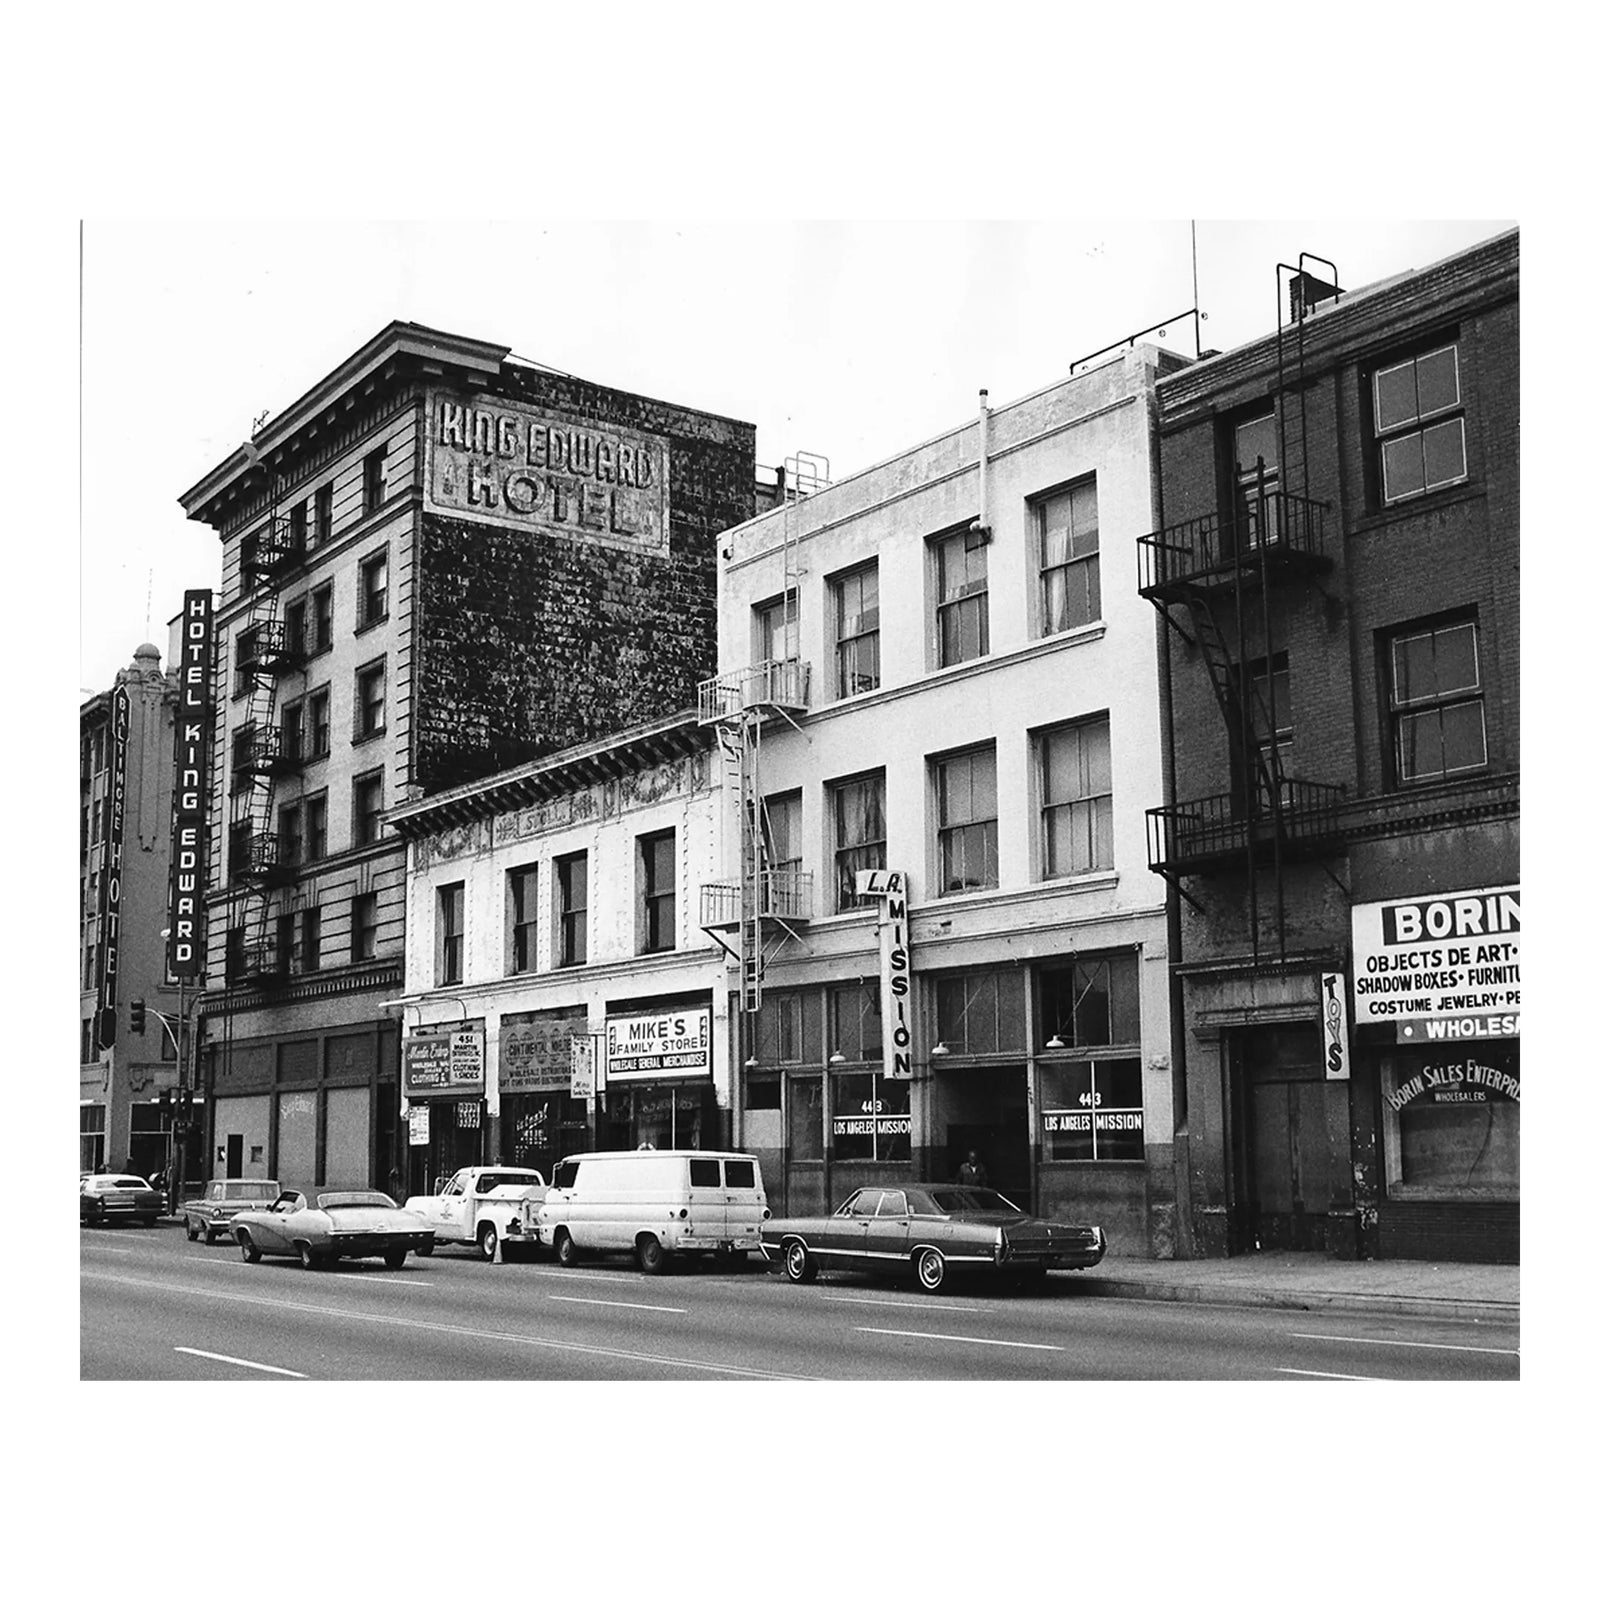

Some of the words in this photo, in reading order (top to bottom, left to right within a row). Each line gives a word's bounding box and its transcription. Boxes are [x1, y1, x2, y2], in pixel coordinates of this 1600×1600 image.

[440, 403, 518, 459] KING
[526, 424, 653, 489] EDWARD
[467, 458, 639, 536] HOTEL
[186, 601, 206, 706] HOTEL
[114, 696, 127, 830] BALTIMORE
[183, 724, 201, 809] KING
[177, 829, 197, 961] EDWARD
[867, 872, 903, 894] L.A.
[105, 842, 121, 1009] HOTEL
[1366, 949, 1443, 973] OBJECTS
[1449, 948, 1471, 966] DE
[889, 899, 910, 1074] MISSION
[1357, 973, 1412, 995] SHADOW
[1414, 969, 1458, 991] BOXES
[1369, 996, 1432, 1015] COSTUME
[1436, 992, 1499, 1011] JEWELRY
[629, 1017, 686, 1040] MIKE'S
[1323, 975, 1343, 1072] TOYS
[458, 1035, 474, 1044] 451
[617, 1042, 654, 1055] FAMILY
[662, 1037, 698, 1052] STORE
[1079, 1092, 1101, 1106] 443
[1386, 1075, 1424, 1111] BORIN
[1435, 1091, 1487, 1102] WHOLESALERS
[861, 1100, 882, 1113] 443
[833, 1121, 846, 1135] LOS
[847, 1120, 874, 1135] ANGELES
[1044, 1116, 1058, 1131] LOS
[1060, 1115, 1091, 1131] ANGELES
[1096, 1114, 1142, 1130] MISSION
